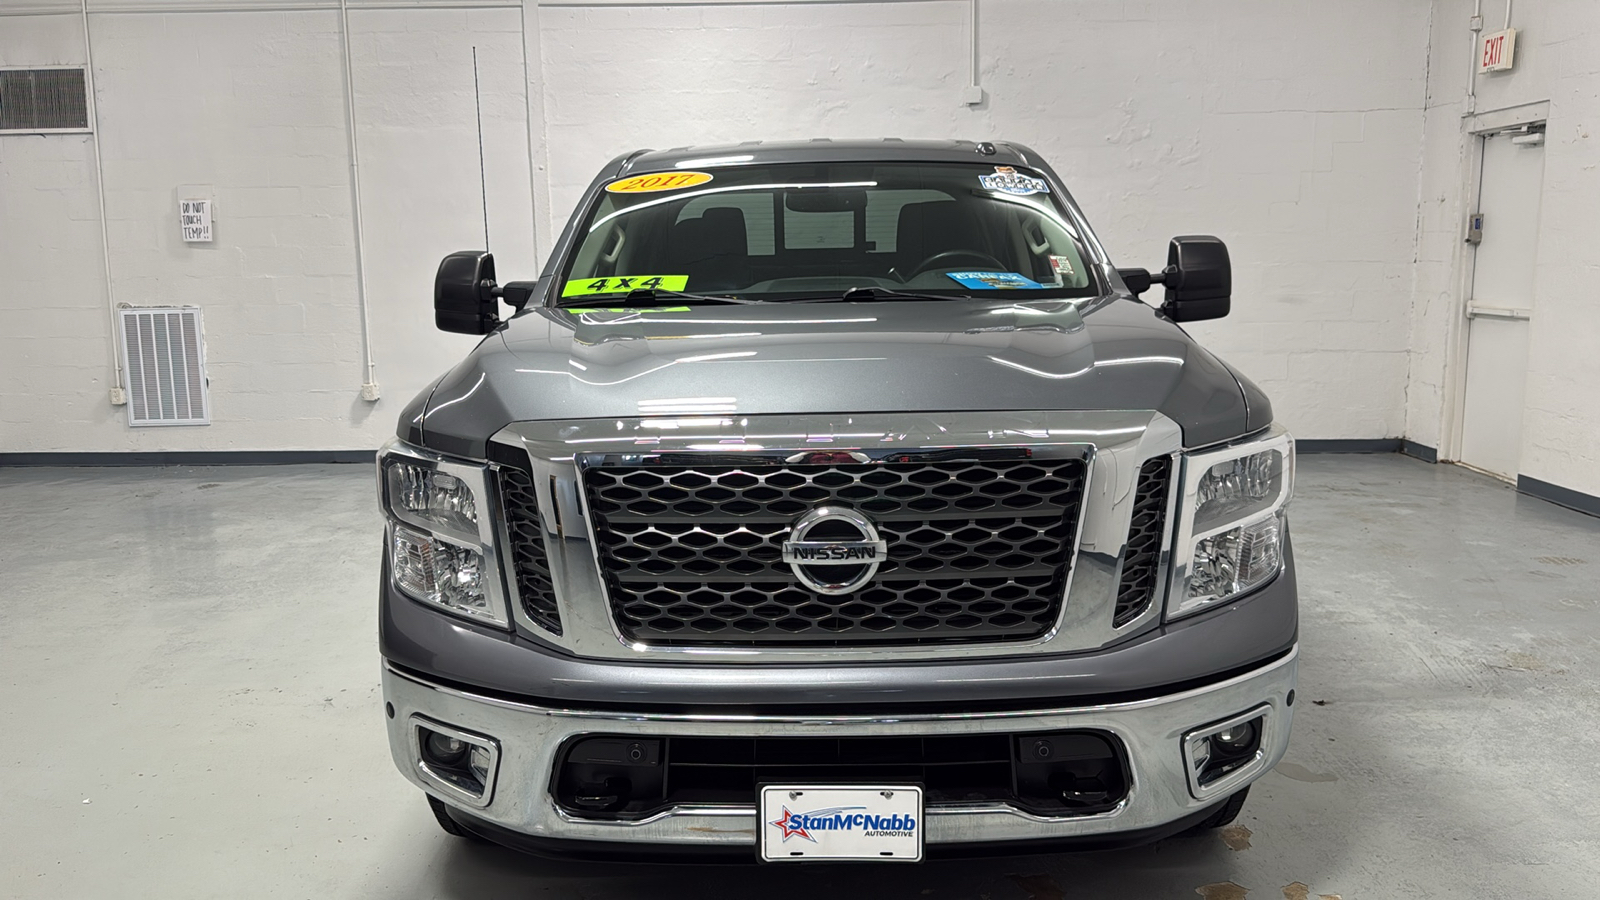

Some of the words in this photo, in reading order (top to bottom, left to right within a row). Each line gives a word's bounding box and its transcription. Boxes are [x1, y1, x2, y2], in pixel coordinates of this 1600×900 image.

[1483, 36, 1504, 67] EXIT
[621, 175, 695, 190] 2017
[182, 202, 190, 214] DO
[192, 202, 206, 214] NOT
[182, 215, 202, 226] TOUCH
[183, 226, 209, 239] TEMP!!
[793, 546, 876, 560] NISSAN
[864, 830, 914, 838] AUTOMOTIVE
